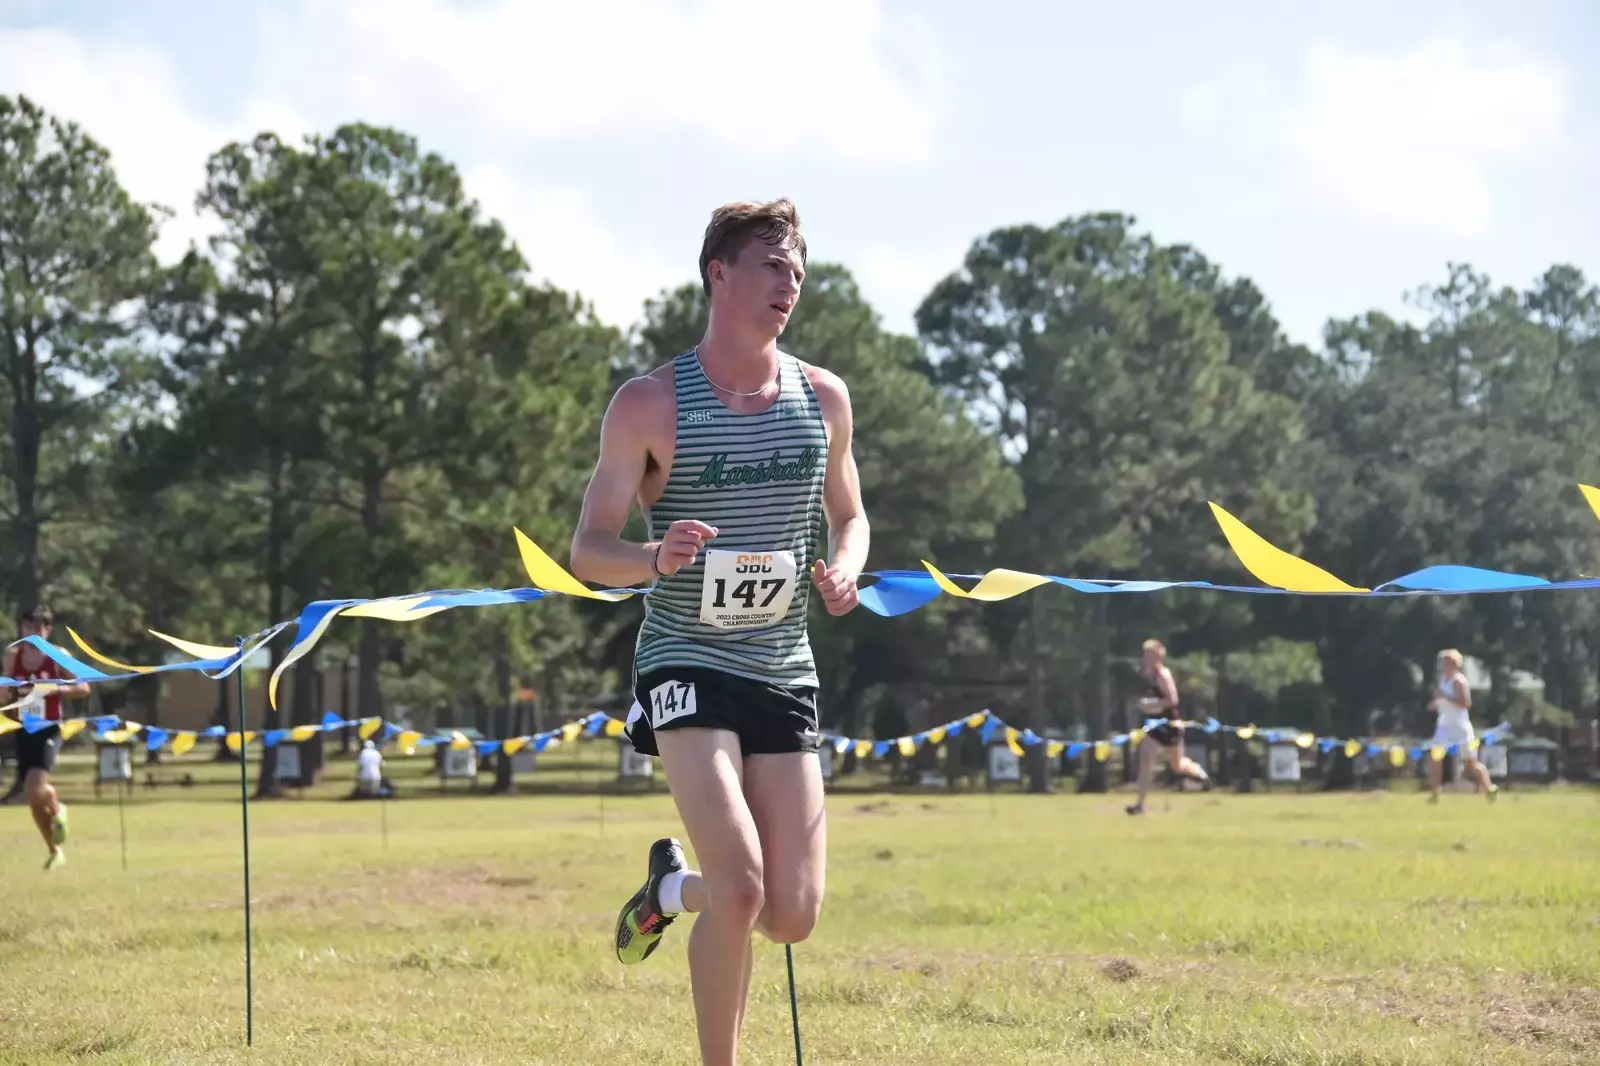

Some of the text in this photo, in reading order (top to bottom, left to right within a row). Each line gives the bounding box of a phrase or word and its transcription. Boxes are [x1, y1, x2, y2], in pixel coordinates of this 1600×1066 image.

[691, 447, 821, 489] Marshall
[712, 578, 787, 608] 147
[655, 683, 691, 720] 147
